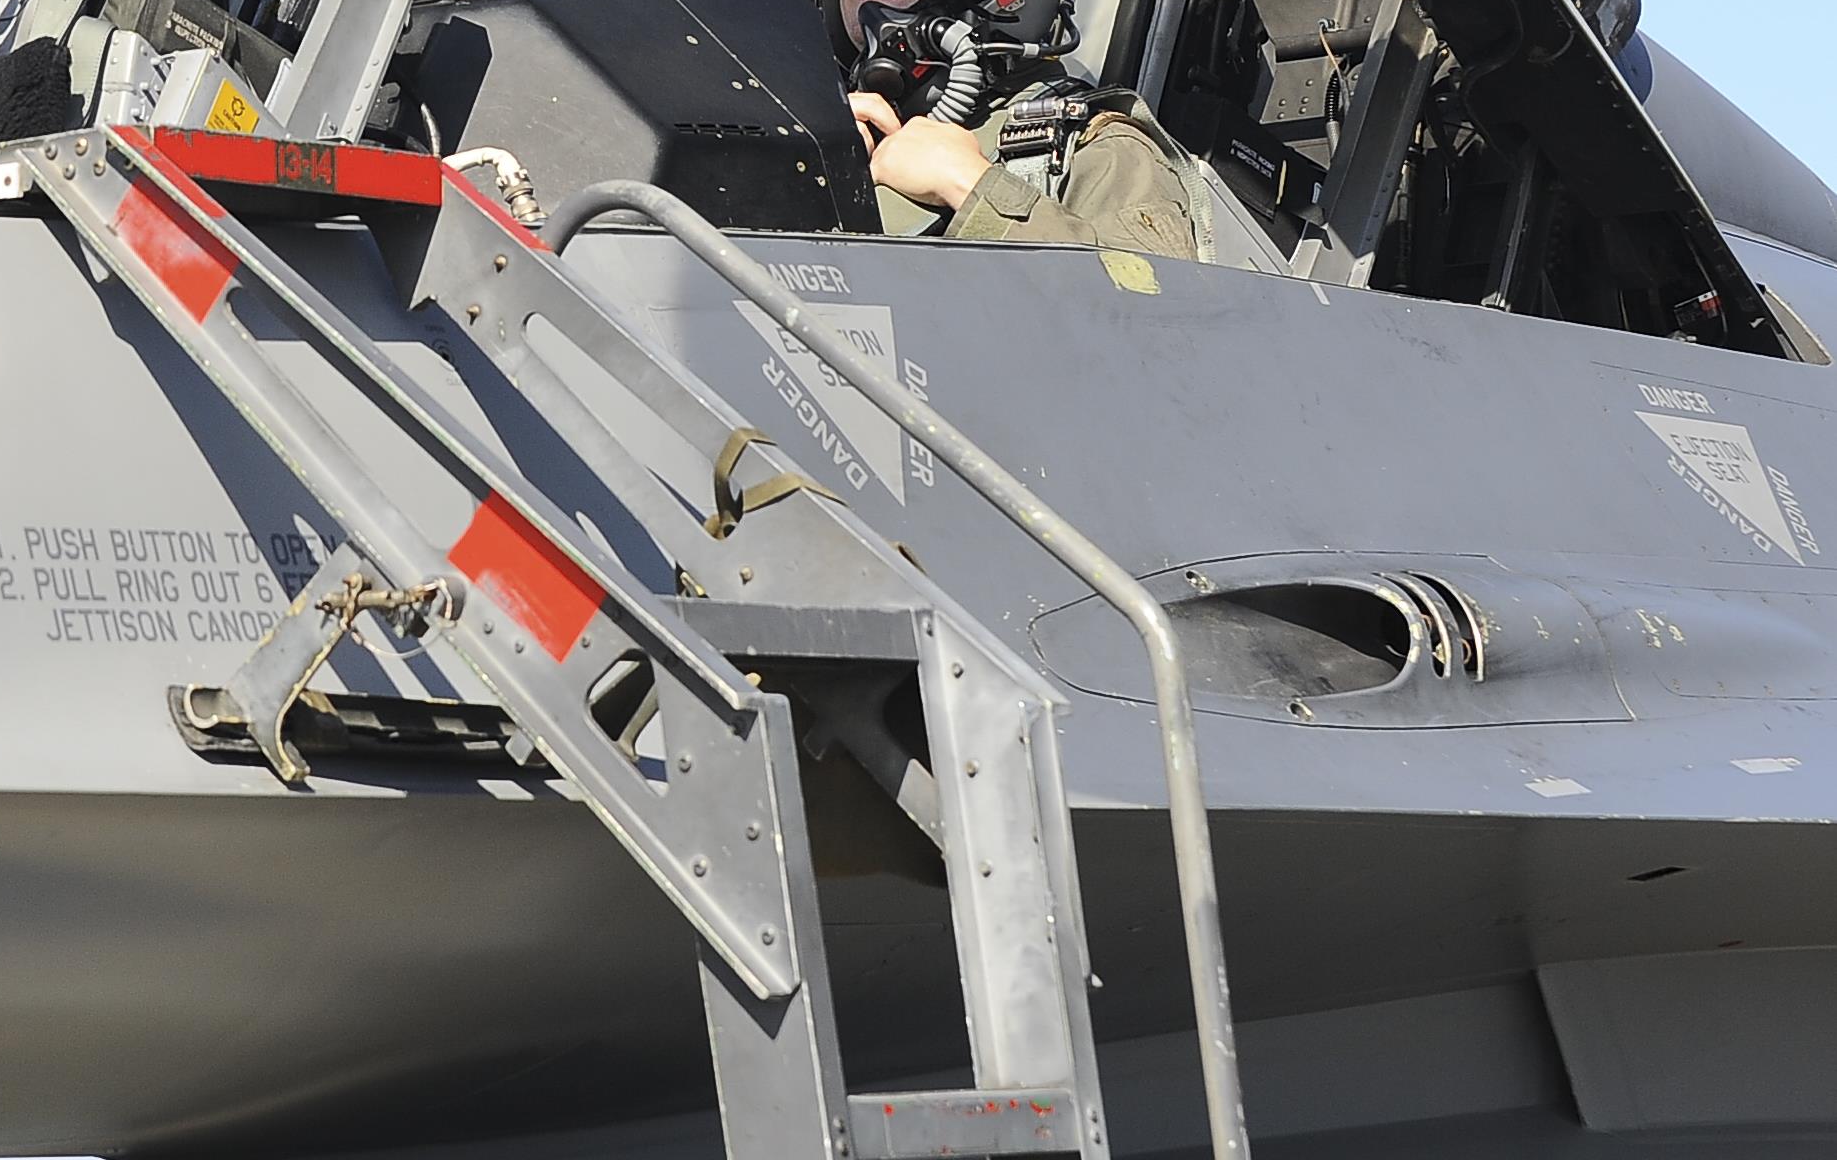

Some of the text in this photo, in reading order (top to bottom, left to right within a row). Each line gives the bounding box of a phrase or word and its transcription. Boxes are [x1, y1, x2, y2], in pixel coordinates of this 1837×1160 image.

[279, 143, 332, 185] 13-14
[766, 263, 851, 294] ANGER
[1638, 383, 1715, 414] DANGER
[762, 356, 869, 491] DANGER
[903, 357, 935, 488] DAER
[1670, 433, 1752, 462] EJECTION
[1706, 460, 1750, 484] SEAT
[1667, 454, 1773, 553] DANGER
[1767, 464, 1821, 555] DANGER
[24, 526, 100, 561] PUSH
[109, 529, 217, 563] BUTTON
[224, 532, 261, 564] TO
[33, 567, 107, 602] PULL
[116, 569, 180, 603] RING
[191, 571, 241, 604] OUT
[255, 572, 273, 603] 6
[46, 608, 279, 642] JETTISON CANOP
